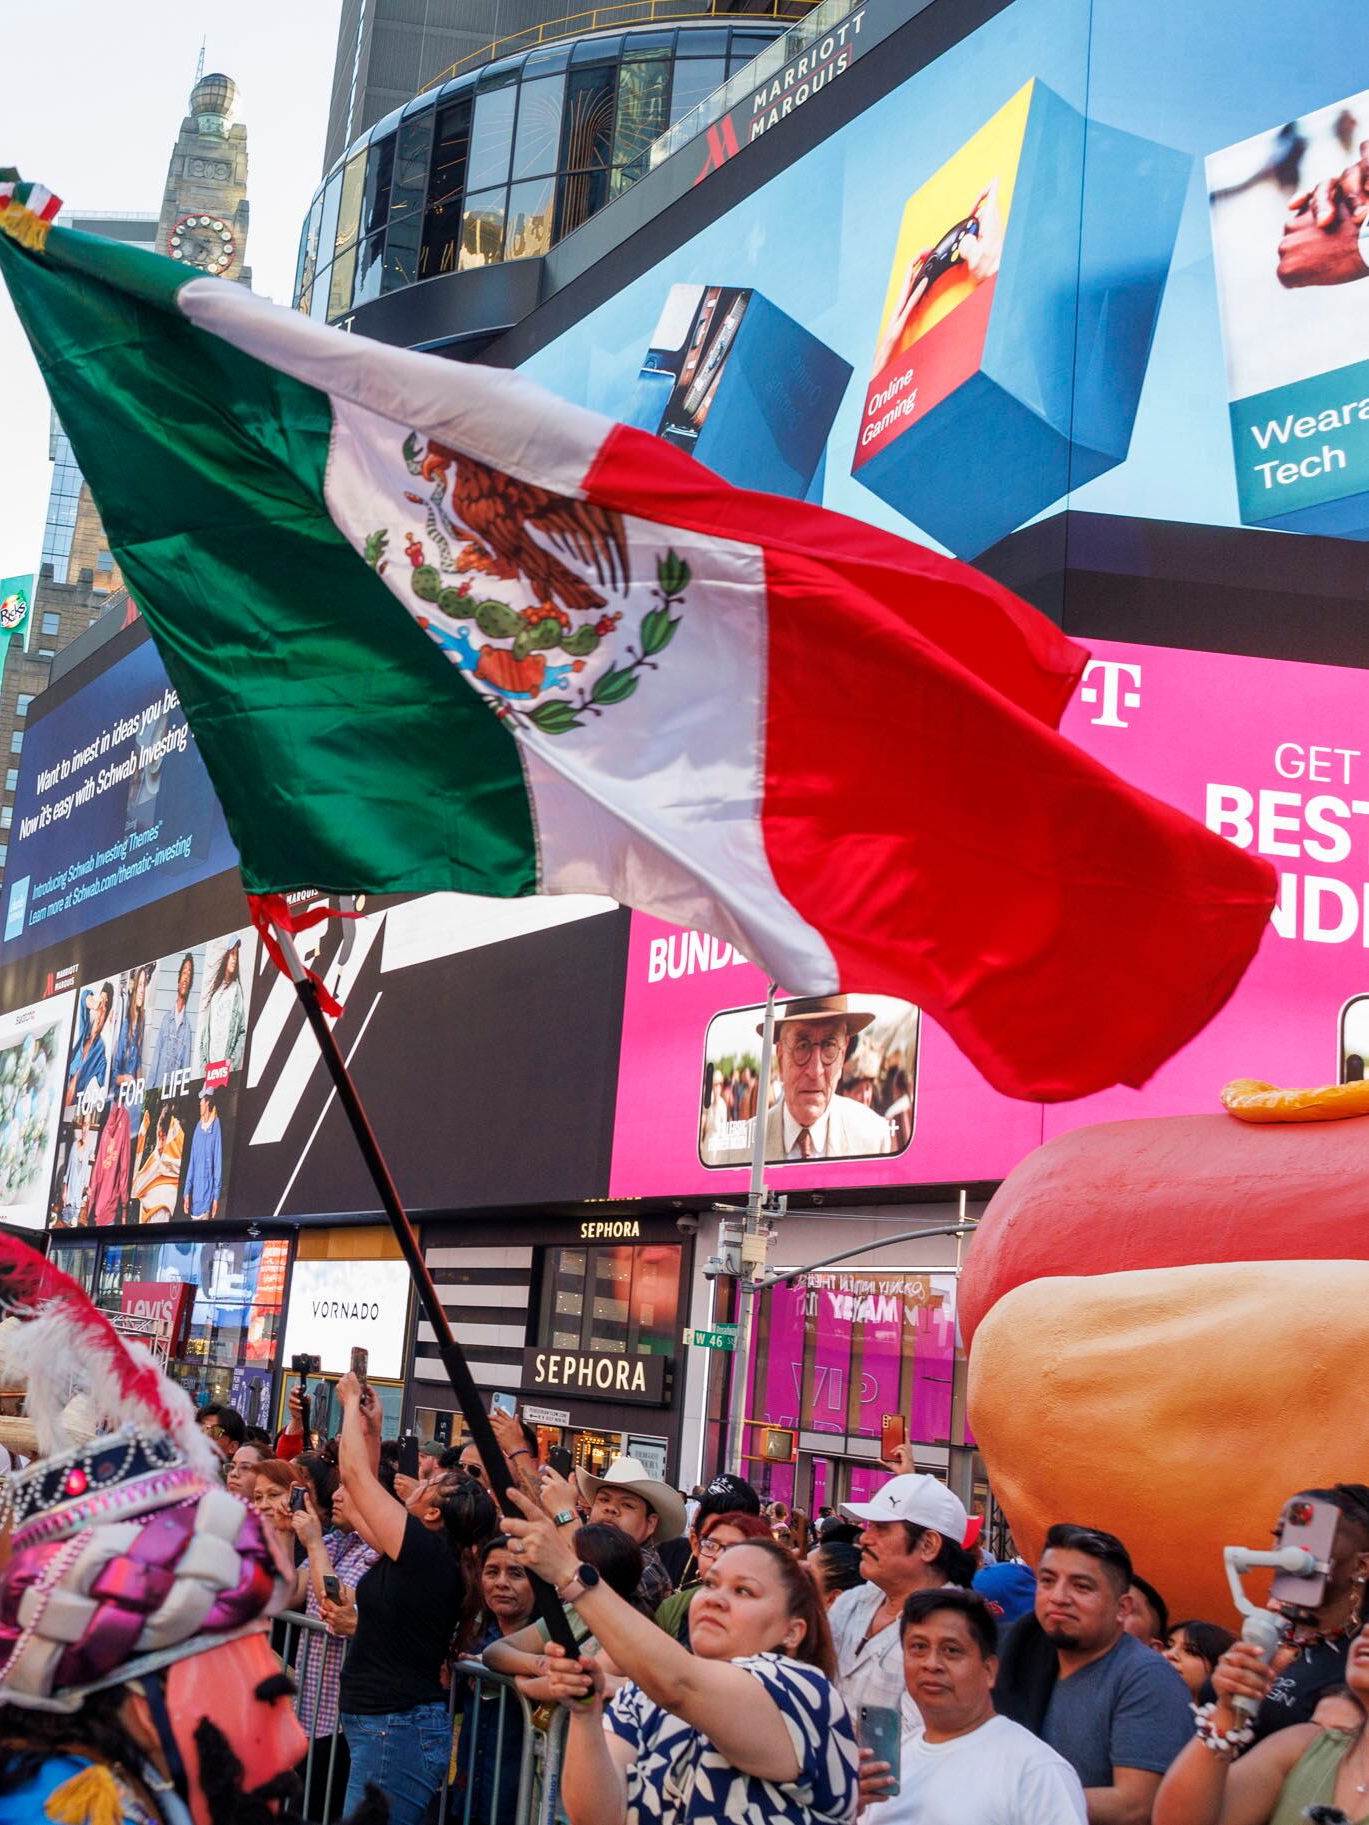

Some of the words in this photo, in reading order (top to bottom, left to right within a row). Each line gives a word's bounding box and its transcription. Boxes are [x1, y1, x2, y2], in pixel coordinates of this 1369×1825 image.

[753, 11, 866, 114] MARRIOTT
[750, 53, 848, 142] MARQUIS
[868, 368, 914, 416] Online
[862, 388, 918, 446] Gaming
[1254, 445, 1346, 488] Tech
[36, 767, 61, 795] Want
[60, 757, 71, 780] to
[71, 738, 100, 773] invest
[100, 729, 111, 753] in
[111, 714, 140, 748] ideas
[139, 700, 162, 736] you
[1275, 742, 1361, 785] GET
[19, 817, 39, 841] Now
[38, 803, 53, 830] it's
[52, 794, 75, 820] easy
[75, 775, 96, 808] with
[96, 751, 137, 794] Schwab
[138, 722, 189, 771] Investing
[28, 905, 47, 926] Learn
[46, 899, 64, 918] more
[64, 894, 73, 910] at
[73, 834, 193, 906] Schwab.com/thematic-investing
[32, 870, 68, 901] Introducing
[68, 857, 95, 883] Schwab
[94, 837, 129, 869] Investing
[286, 889, 319, 905] MARQUIS
[76, 1087, 106, 1117] TOPS
[118, 1078, 146, 1107] FOR
[161, 1067, 191, 1100] LIFE
[580, 1221, 640, 1238] SEPHORA
[312, 1300, 380, 1321] VORNADO
[695, 1332, 705, 1345] W
[709, 1334, 723, 1348] 46
[534, 1354, 646, 1392] SEPHORA
[791, 1362, 879, 1411] VIP
